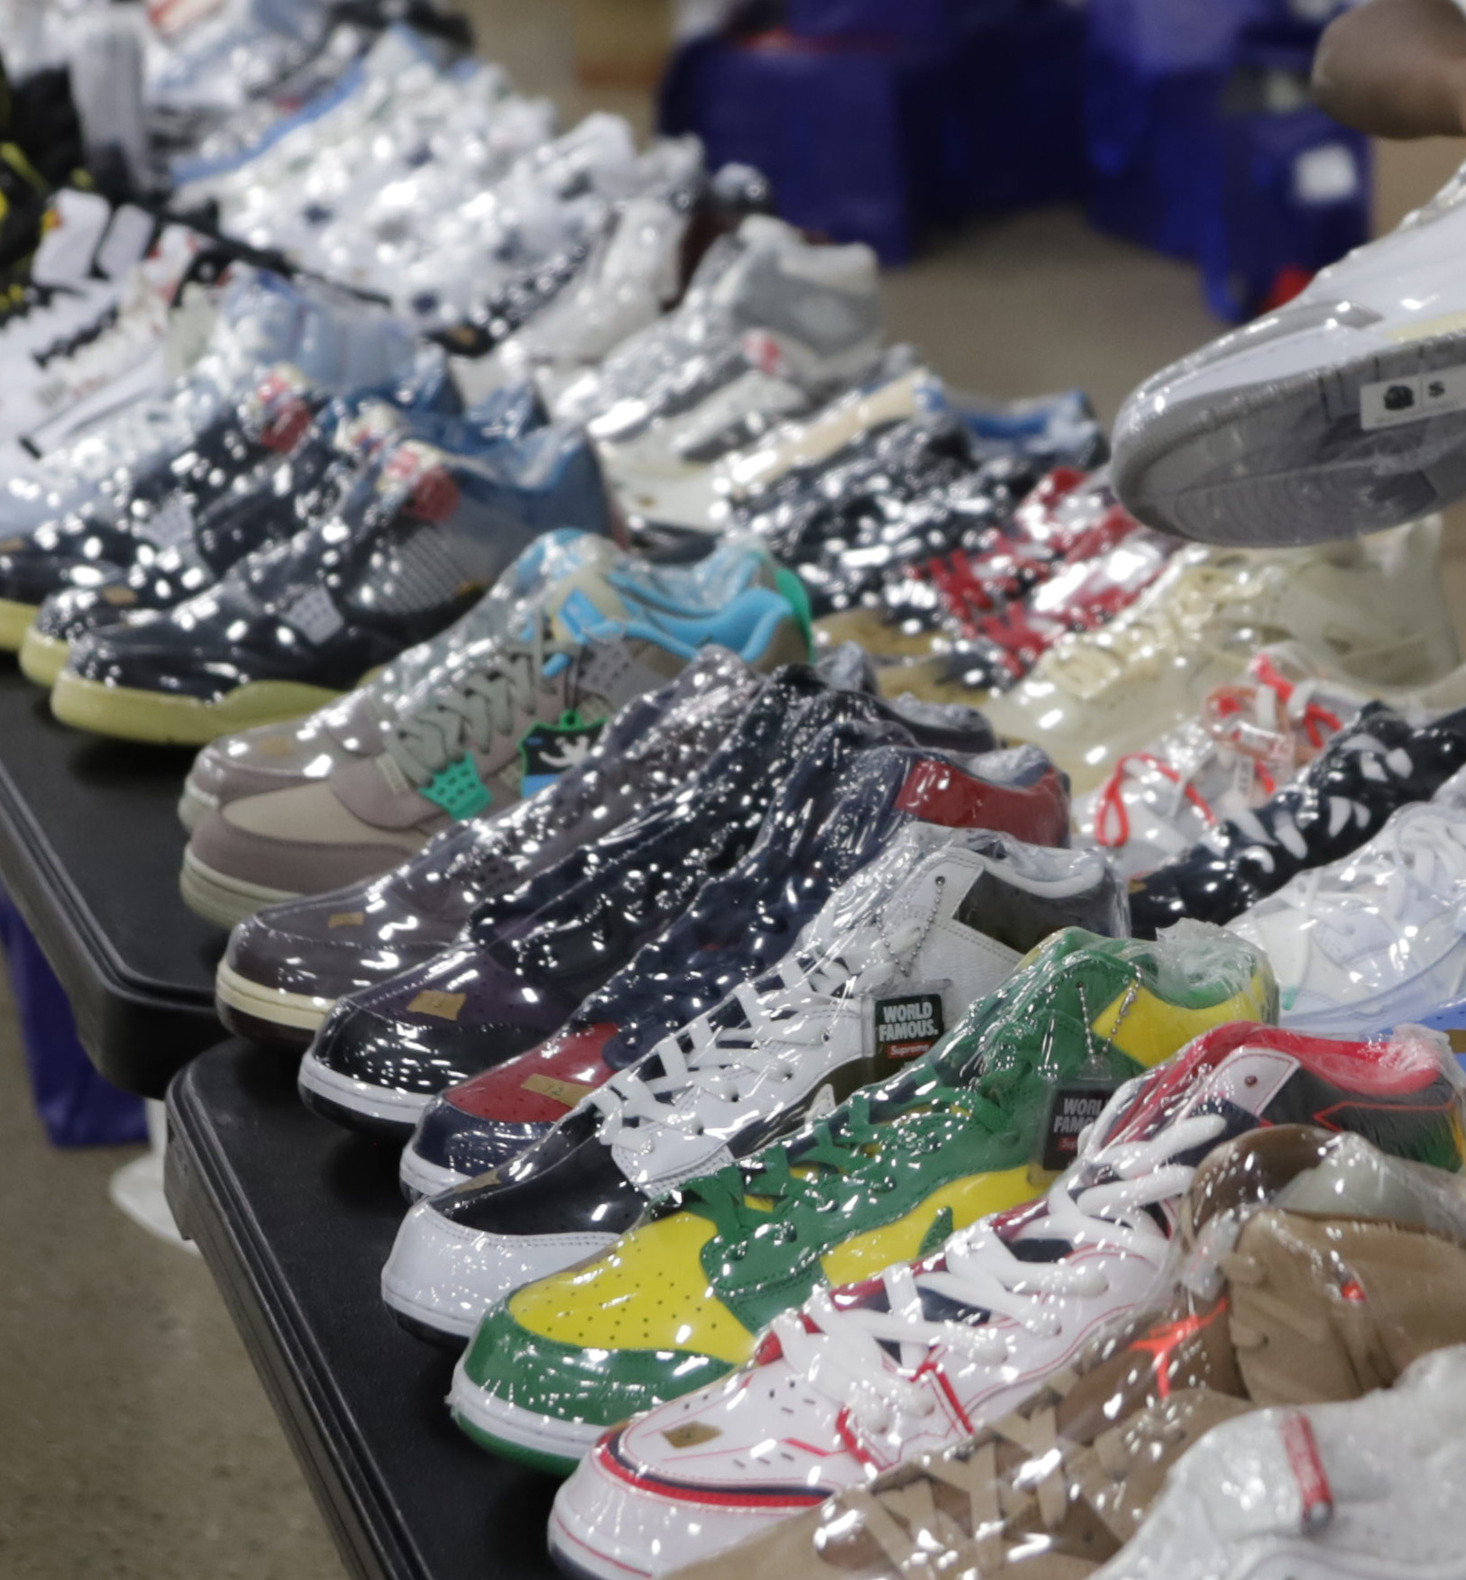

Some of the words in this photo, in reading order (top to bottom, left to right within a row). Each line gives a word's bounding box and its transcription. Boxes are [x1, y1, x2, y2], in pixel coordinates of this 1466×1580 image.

[882, 1002, 933, 1023] WORLD
[878, 1019, 939, 1042] FAMOUS.
[1064, 1098, 1109, 1116] WORL
